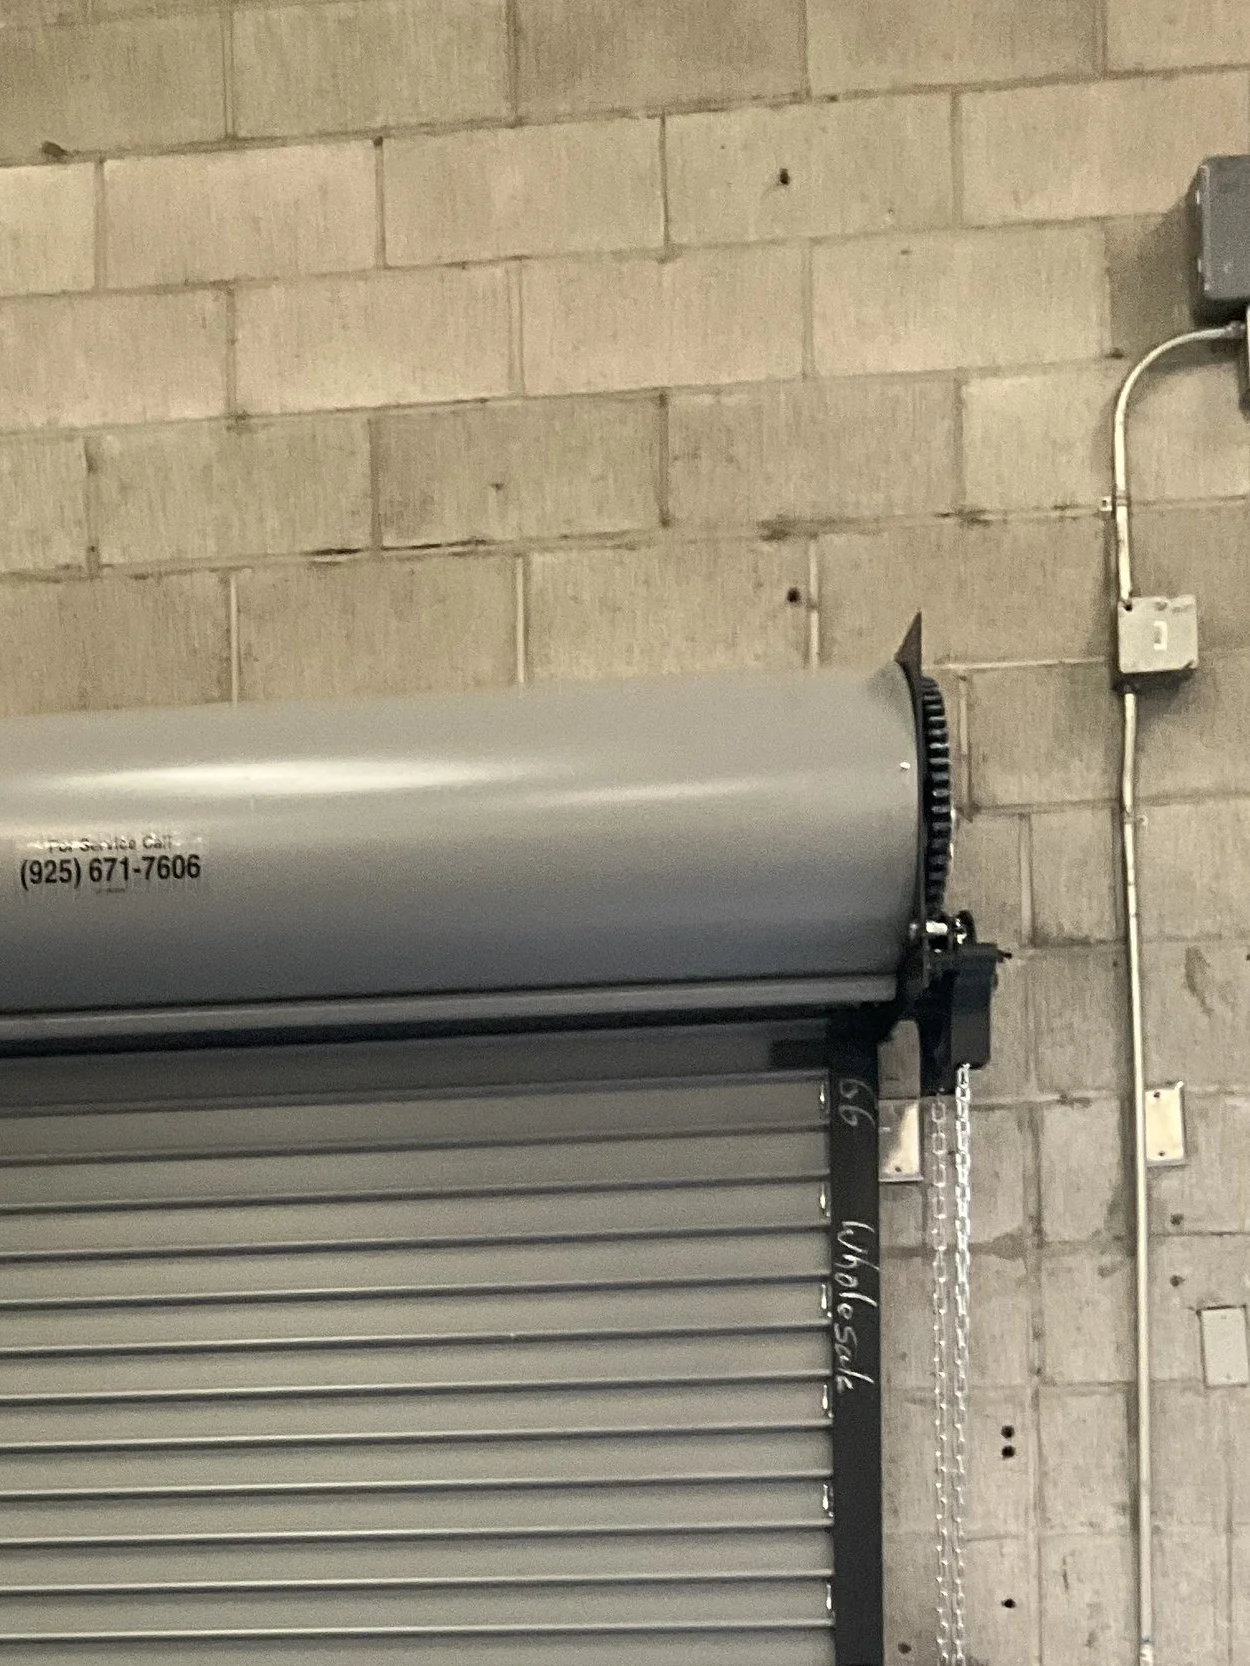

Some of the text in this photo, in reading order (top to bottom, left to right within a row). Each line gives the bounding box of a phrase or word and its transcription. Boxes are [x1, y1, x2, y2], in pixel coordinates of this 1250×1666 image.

[20, 853, 201, 892] (925) 671-7606
[834, 1220, 879, 1395] Wholesale
